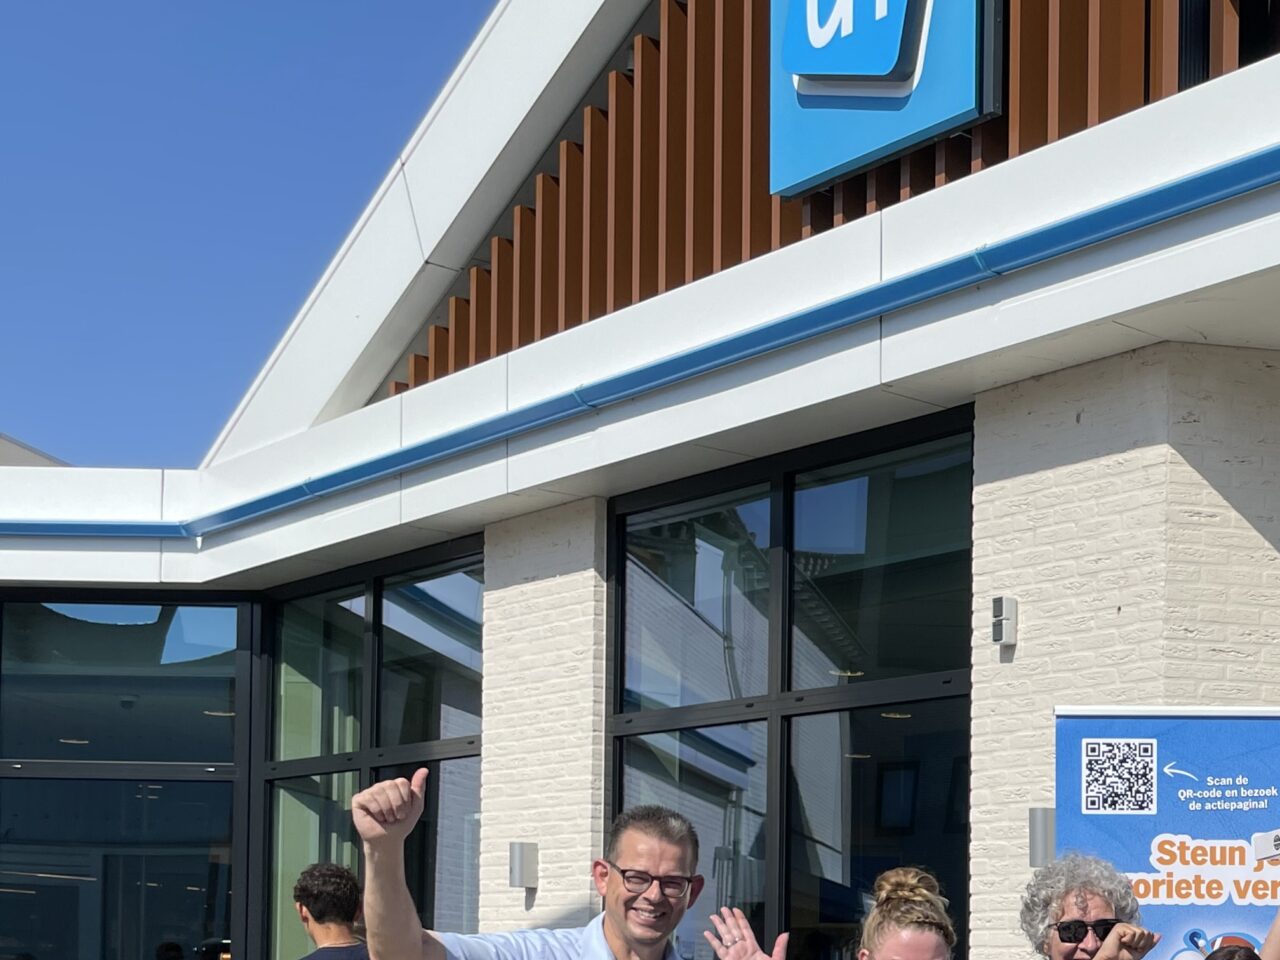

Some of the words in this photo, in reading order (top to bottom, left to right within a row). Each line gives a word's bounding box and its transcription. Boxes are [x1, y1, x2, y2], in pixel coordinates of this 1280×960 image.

[1206, 776, 1233, 786] Scan
[1235, 775, 1249, 785] de
[1178, 788, 1223, 801] QR-code
[1225, 789, 1238, 798] en
[1240, 786, 1278, 797] bezoek
[1189, 801, 1202, 811] de
[1204, 799, 1268, 811] actiepagina!
[1156, 840, 1246, 866] Steun
[1130, 872, 1224, 899] oriete
